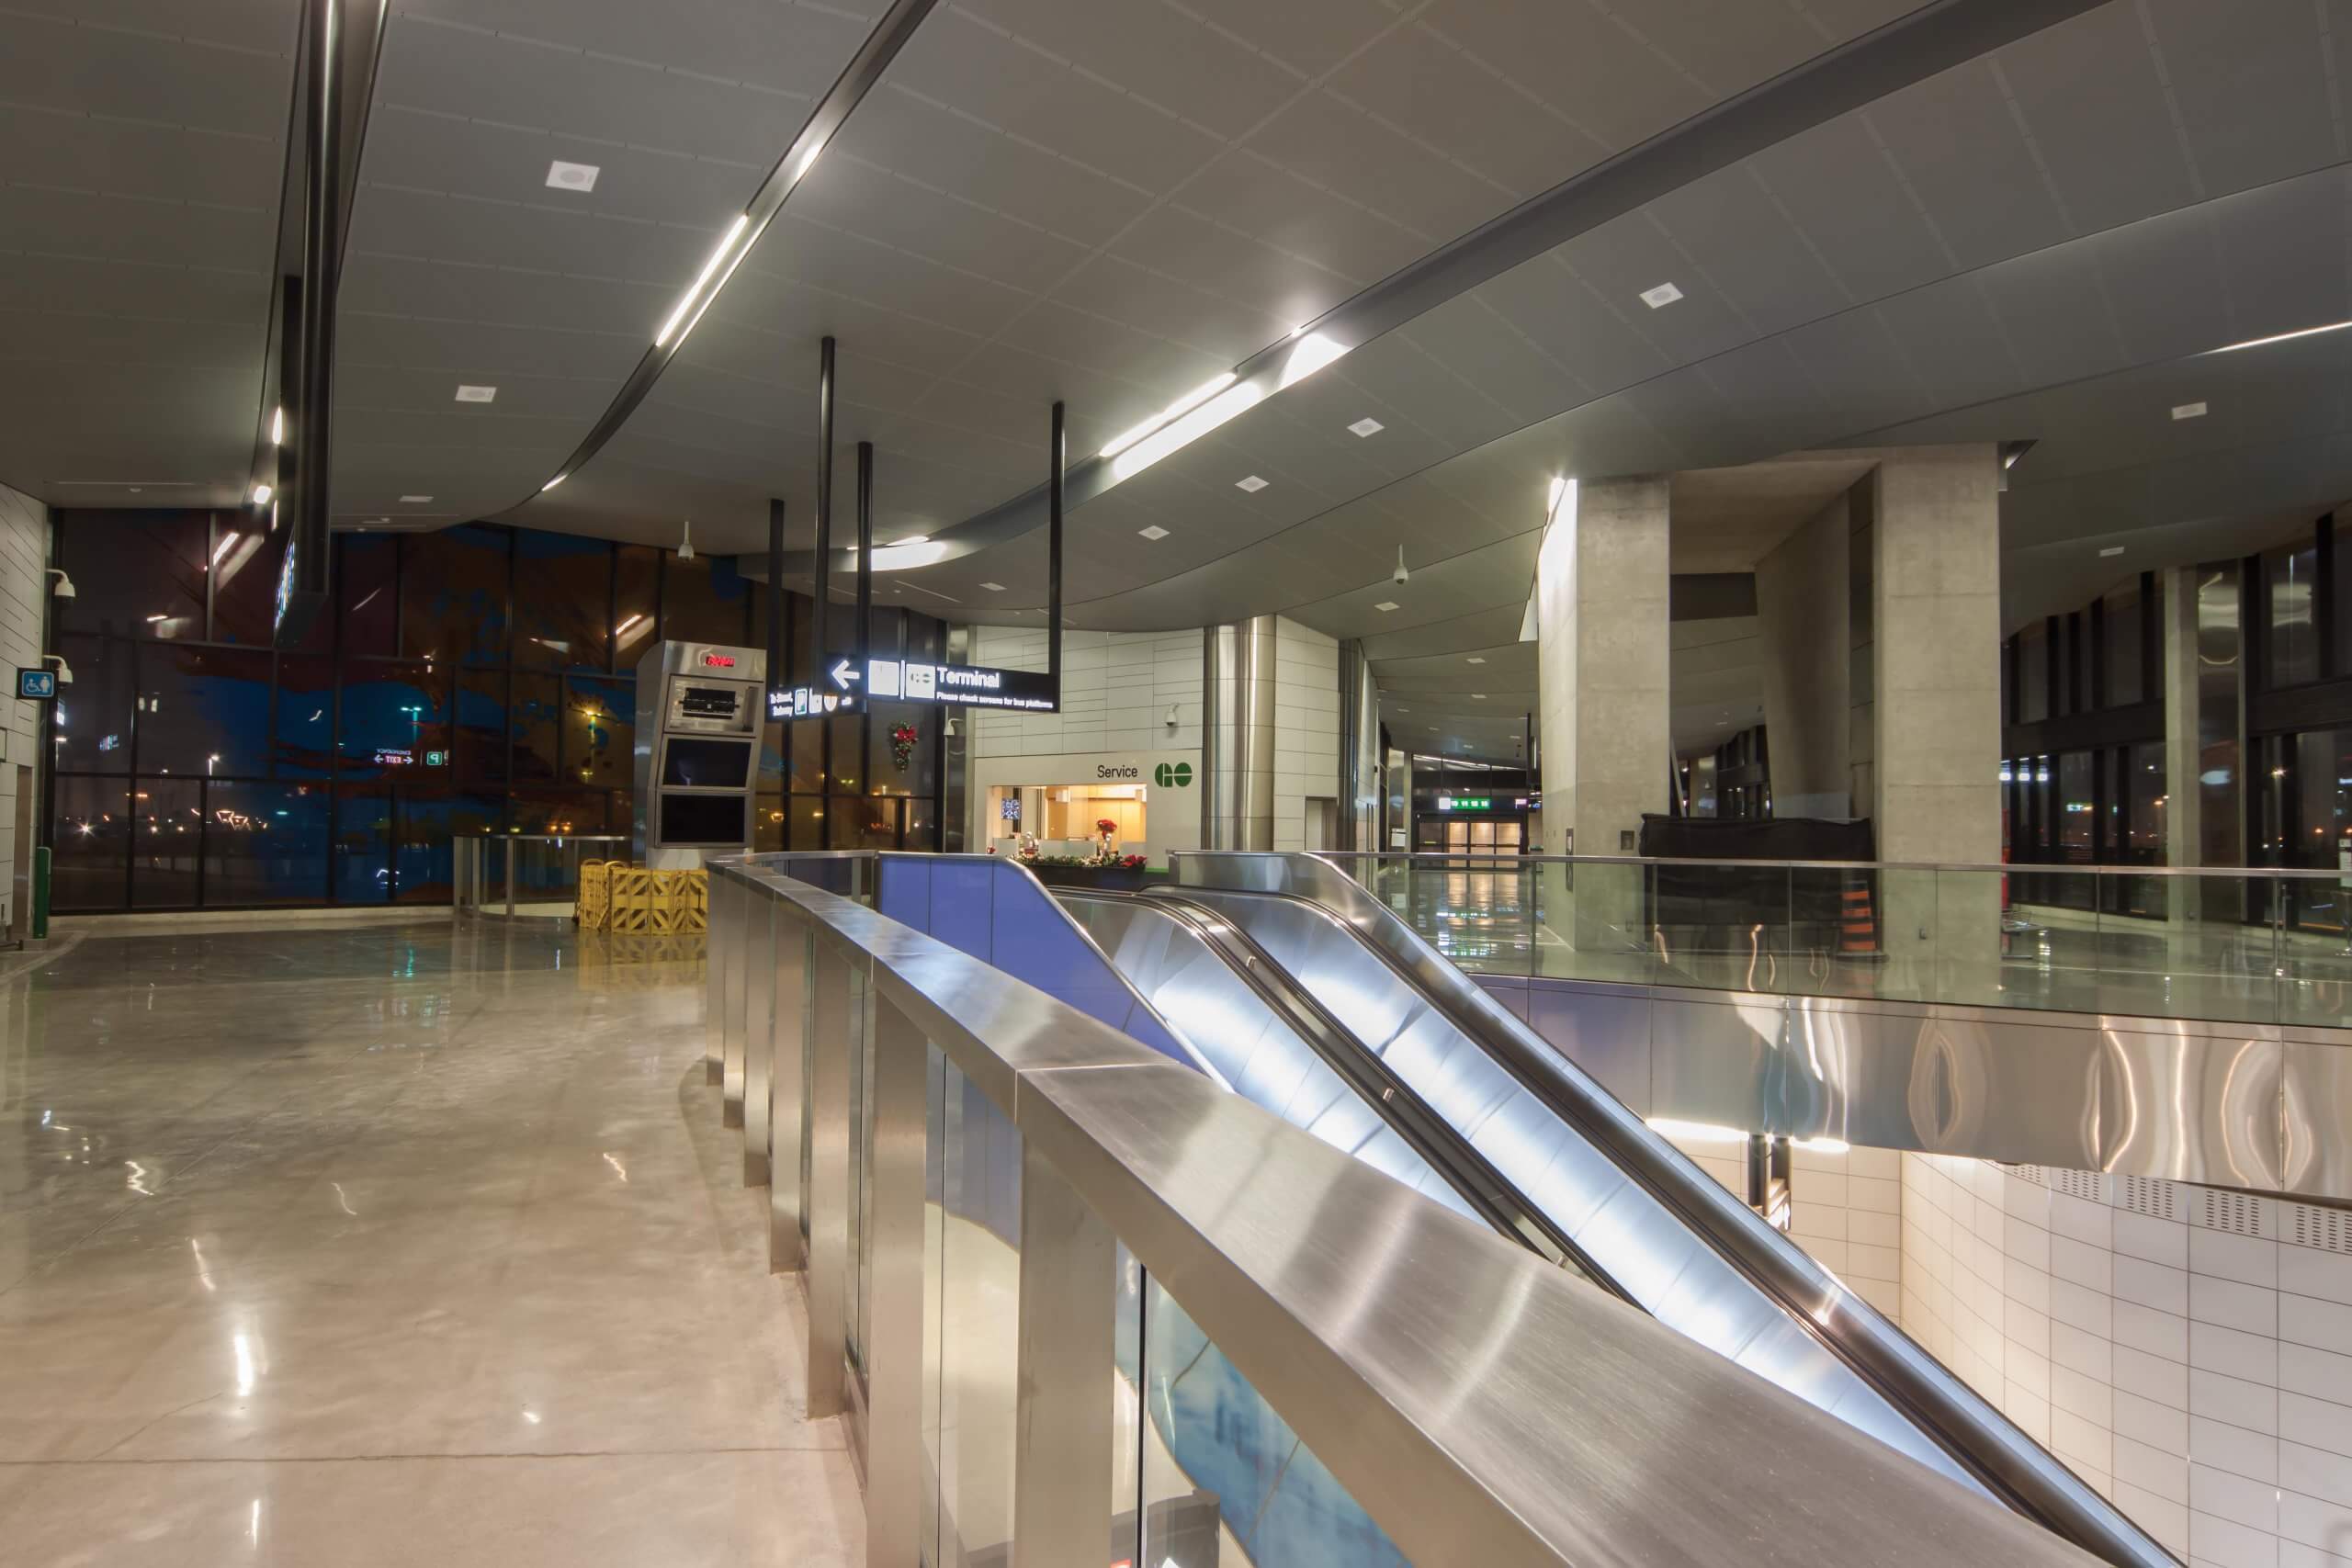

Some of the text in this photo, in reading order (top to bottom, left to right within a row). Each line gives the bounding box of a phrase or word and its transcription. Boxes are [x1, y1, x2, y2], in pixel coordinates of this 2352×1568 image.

[937, 667, 1000, 688] Terminal
[1097, 765, 1138, 778] Service
[1155, 762, 1193, 787] GO
